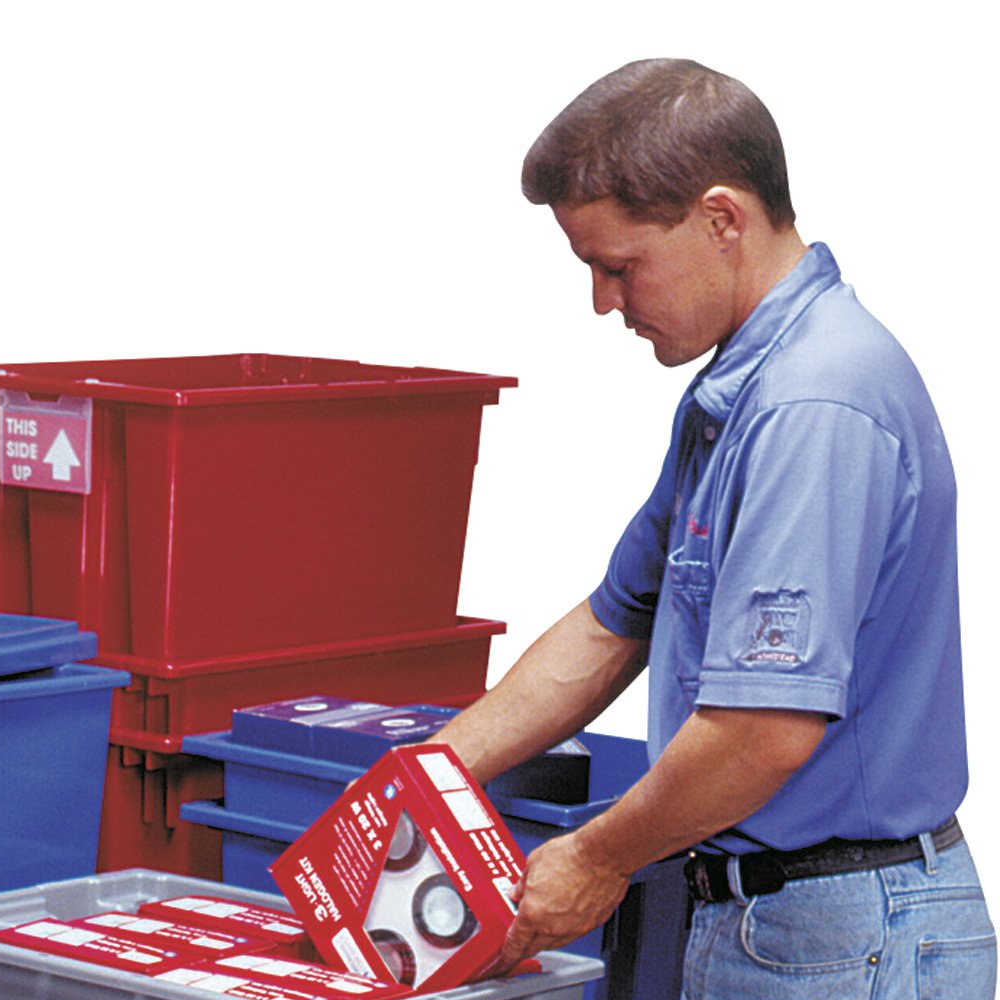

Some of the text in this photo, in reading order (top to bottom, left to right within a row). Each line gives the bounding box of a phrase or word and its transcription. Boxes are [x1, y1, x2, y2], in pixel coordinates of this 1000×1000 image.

[6, 417, 38, 437] THIS
[6, 441, 38, 460] SIDE
[12, 463, 32, 481] UP
[430, 827, 472, 891] Easy Installation
[299, 857, 341, 921] HALOGEN KIT
